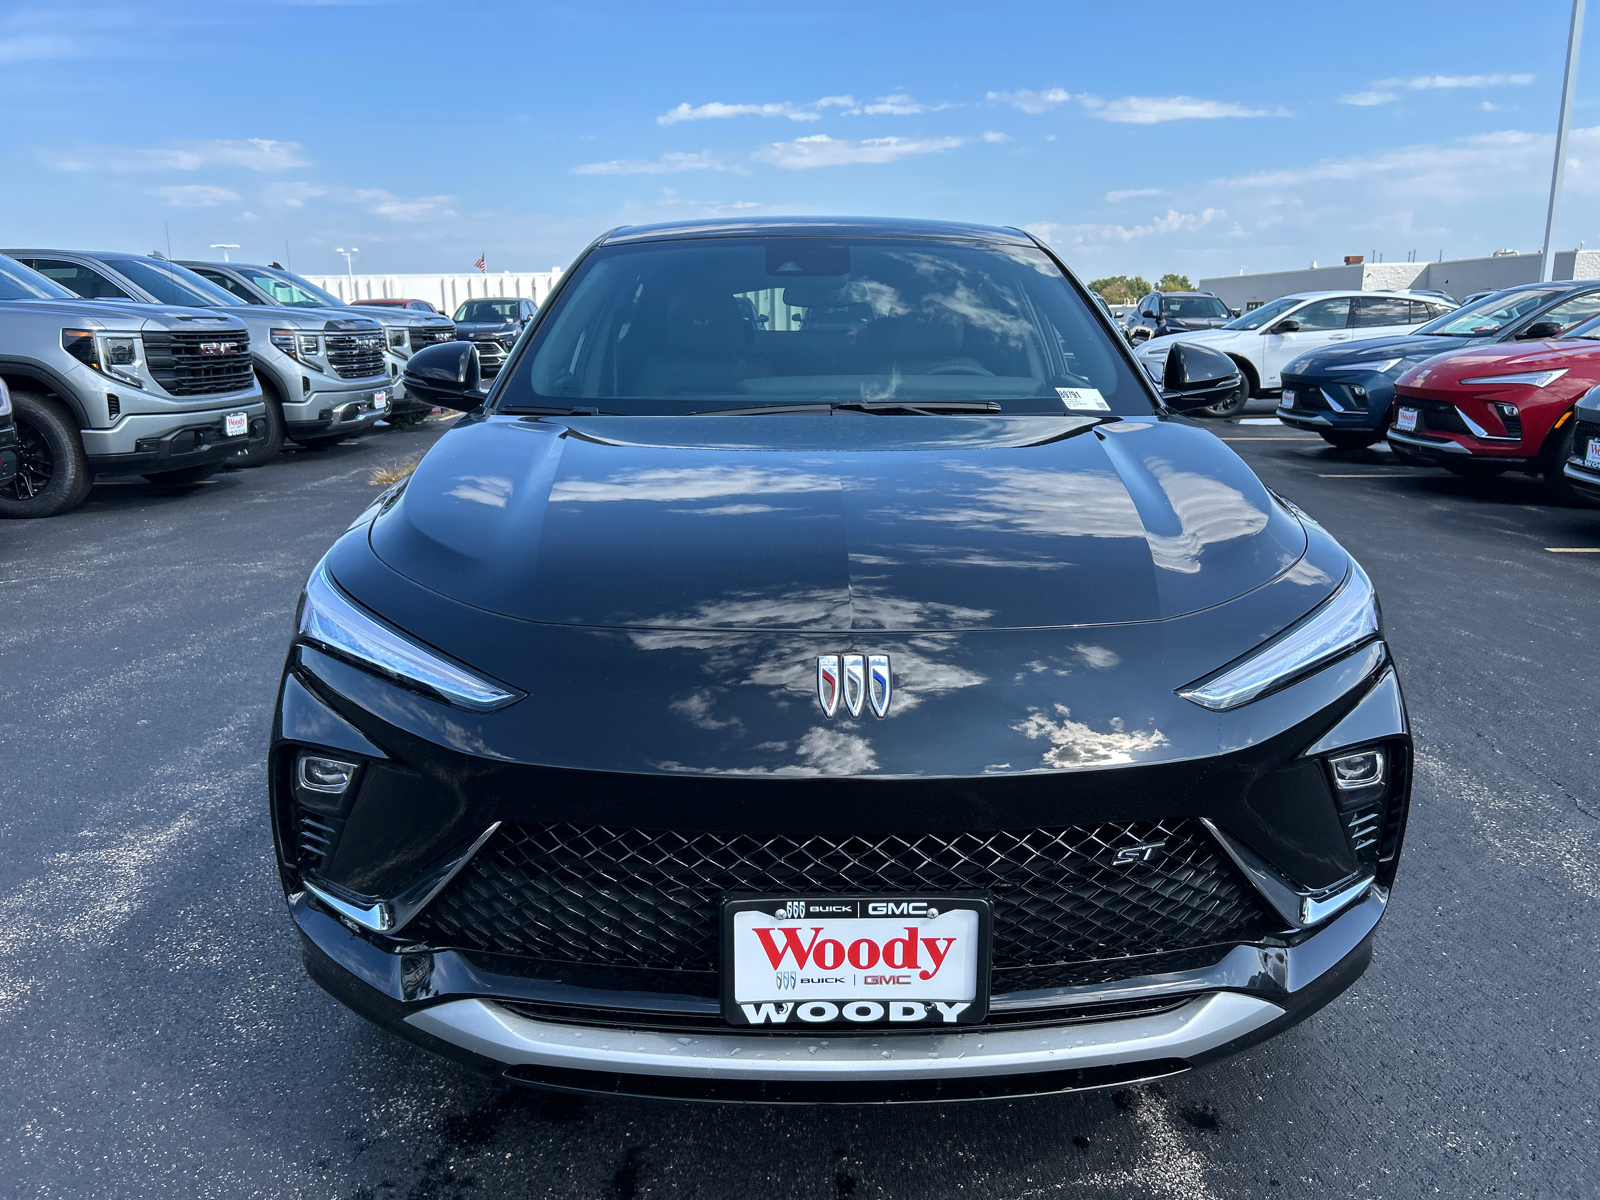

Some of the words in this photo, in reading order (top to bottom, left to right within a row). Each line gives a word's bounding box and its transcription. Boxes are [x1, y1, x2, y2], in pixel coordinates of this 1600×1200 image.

[1112, 841, 1166, 866] ST
[809, 905, 852, 913] BUICK
[867, 902, 928, 915] GMC
[752, 926, 957, 980] Woody
[800, 976, 846, 984] BUICK
[863, 975, 912, 985] GMC
[740, 1001, 971, 1024] WOODY
